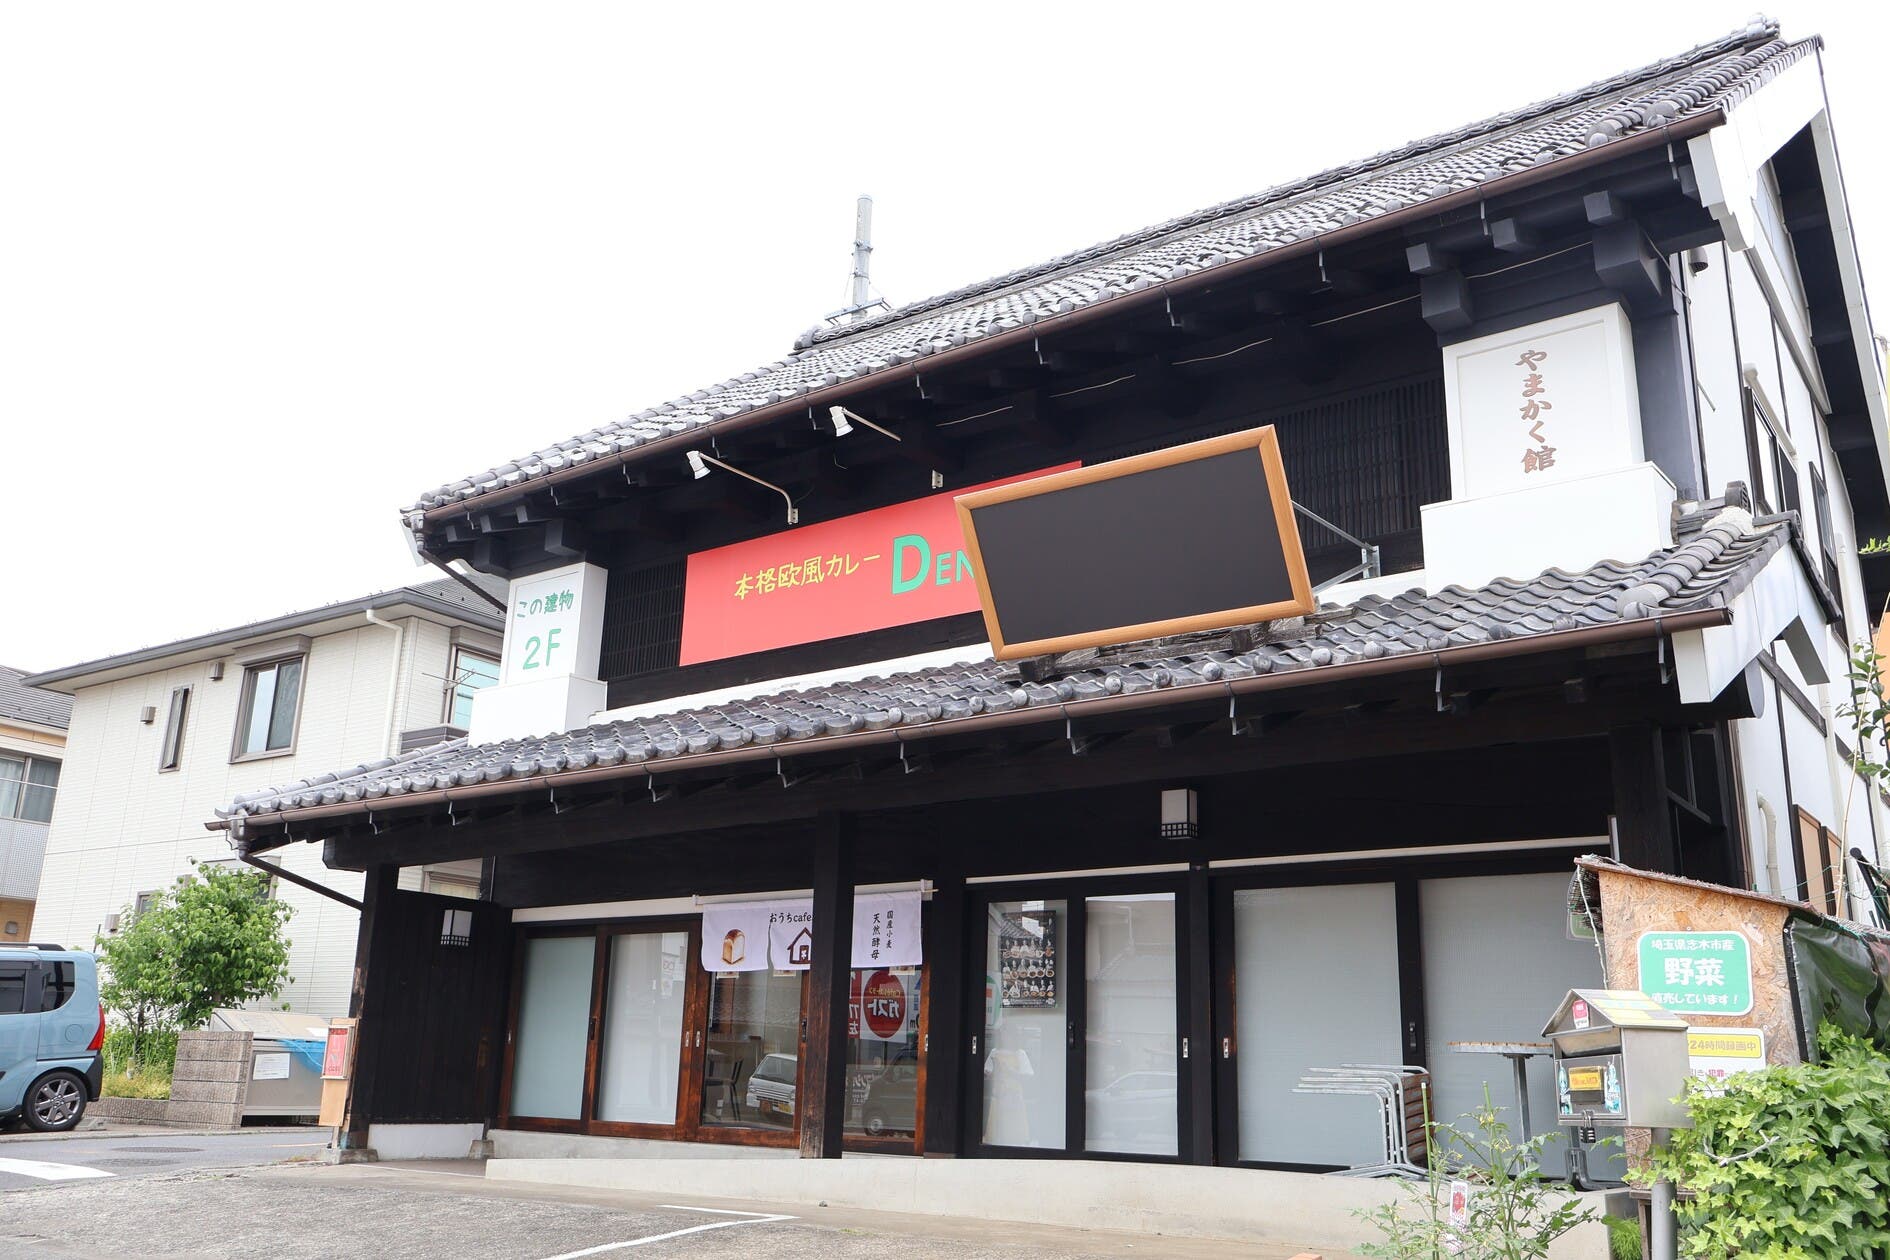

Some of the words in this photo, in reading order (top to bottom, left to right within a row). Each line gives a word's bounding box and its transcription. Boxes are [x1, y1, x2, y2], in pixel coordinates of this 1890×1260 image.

[1515, 349, 1557, 473] やまかく館
[734, 553, 881, 600] 本格欧風カレー
[517, 588, 574, 618] この建物
[523, 628, 561, 670] 2F
[871, 912, 881, 960] 天然酵母
[1651, 938, 1735, 951] 埼玉県志木市産
[1664, 957, 1725, 986] 野菜
